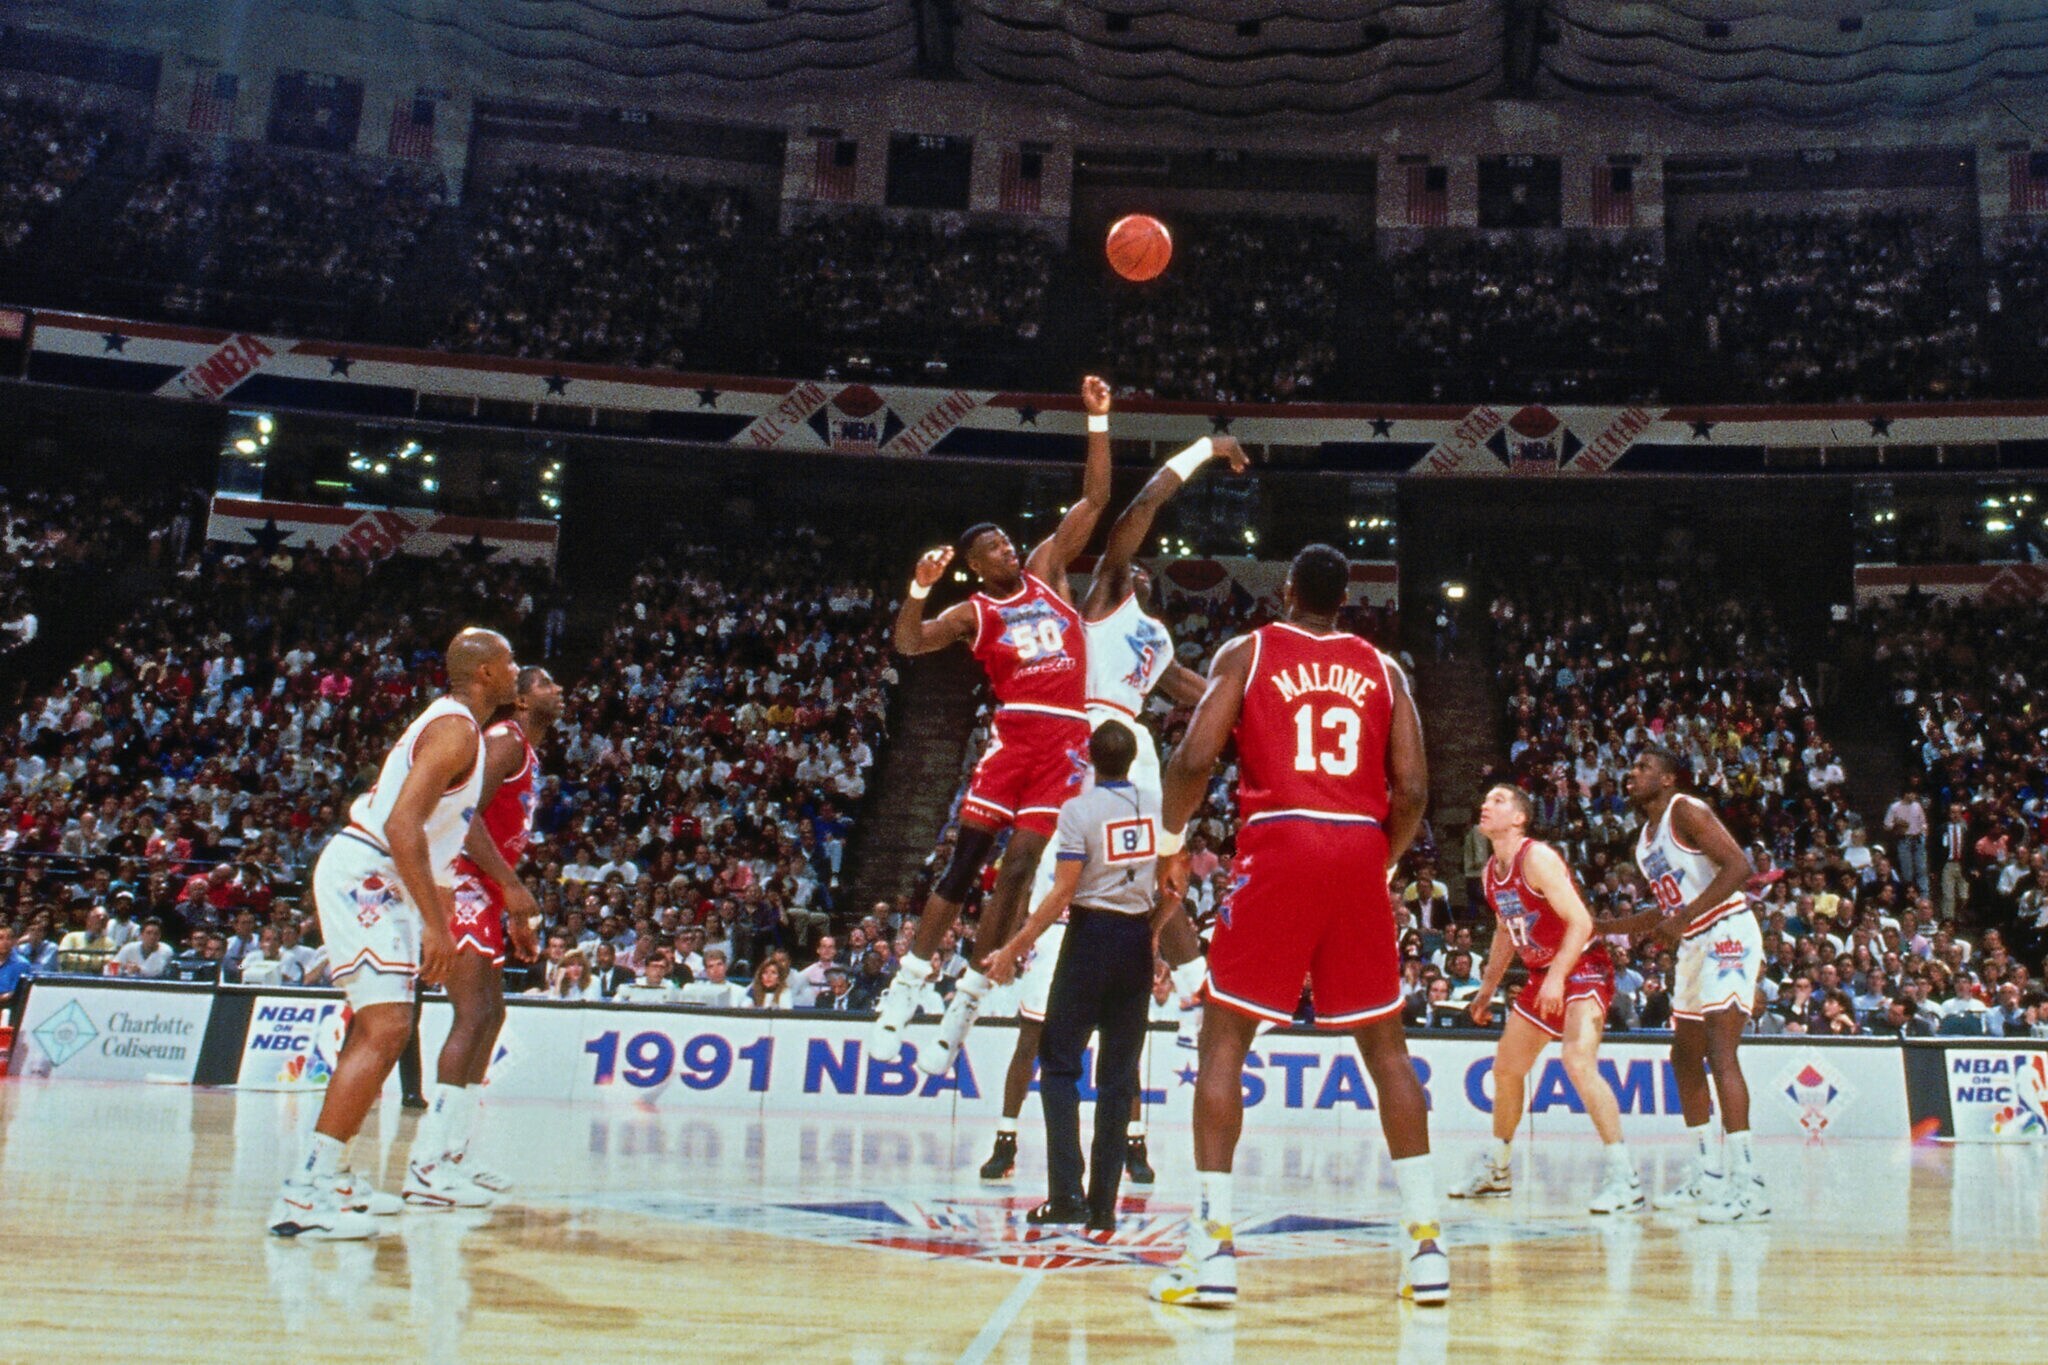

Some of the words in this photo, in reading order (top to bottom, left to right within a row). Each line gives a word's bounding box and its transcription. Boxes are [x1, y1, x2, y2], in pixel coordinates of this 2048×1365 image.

[196, 335, 276, 397] NBA
[1011, 619, 1064, 660] 50
[1271, 662, 1377, 708] MALONE
[1293, 703, 1362, 777] 13
[1122, 829, 1138, 851] 8
[1505, 916, 1529, 947] 17
[108, 1011, 194, 1036] Charlotte
[257, 1006, 316, 1022] NBA
[273, 1024, 293, 1032] ON
[101, 1035, 187, 1060] Coliseum
[251, 1033, 310, 1051] NBC
[584, 1030, 776, 1093] 1991
[803, 1038, 981, 1099] NBA
[1953, 1058, 2010, 1074] NBA
[1972, 1076, 1991, 1085] ON
[1956, 1087, 2012, 1104] NBC
